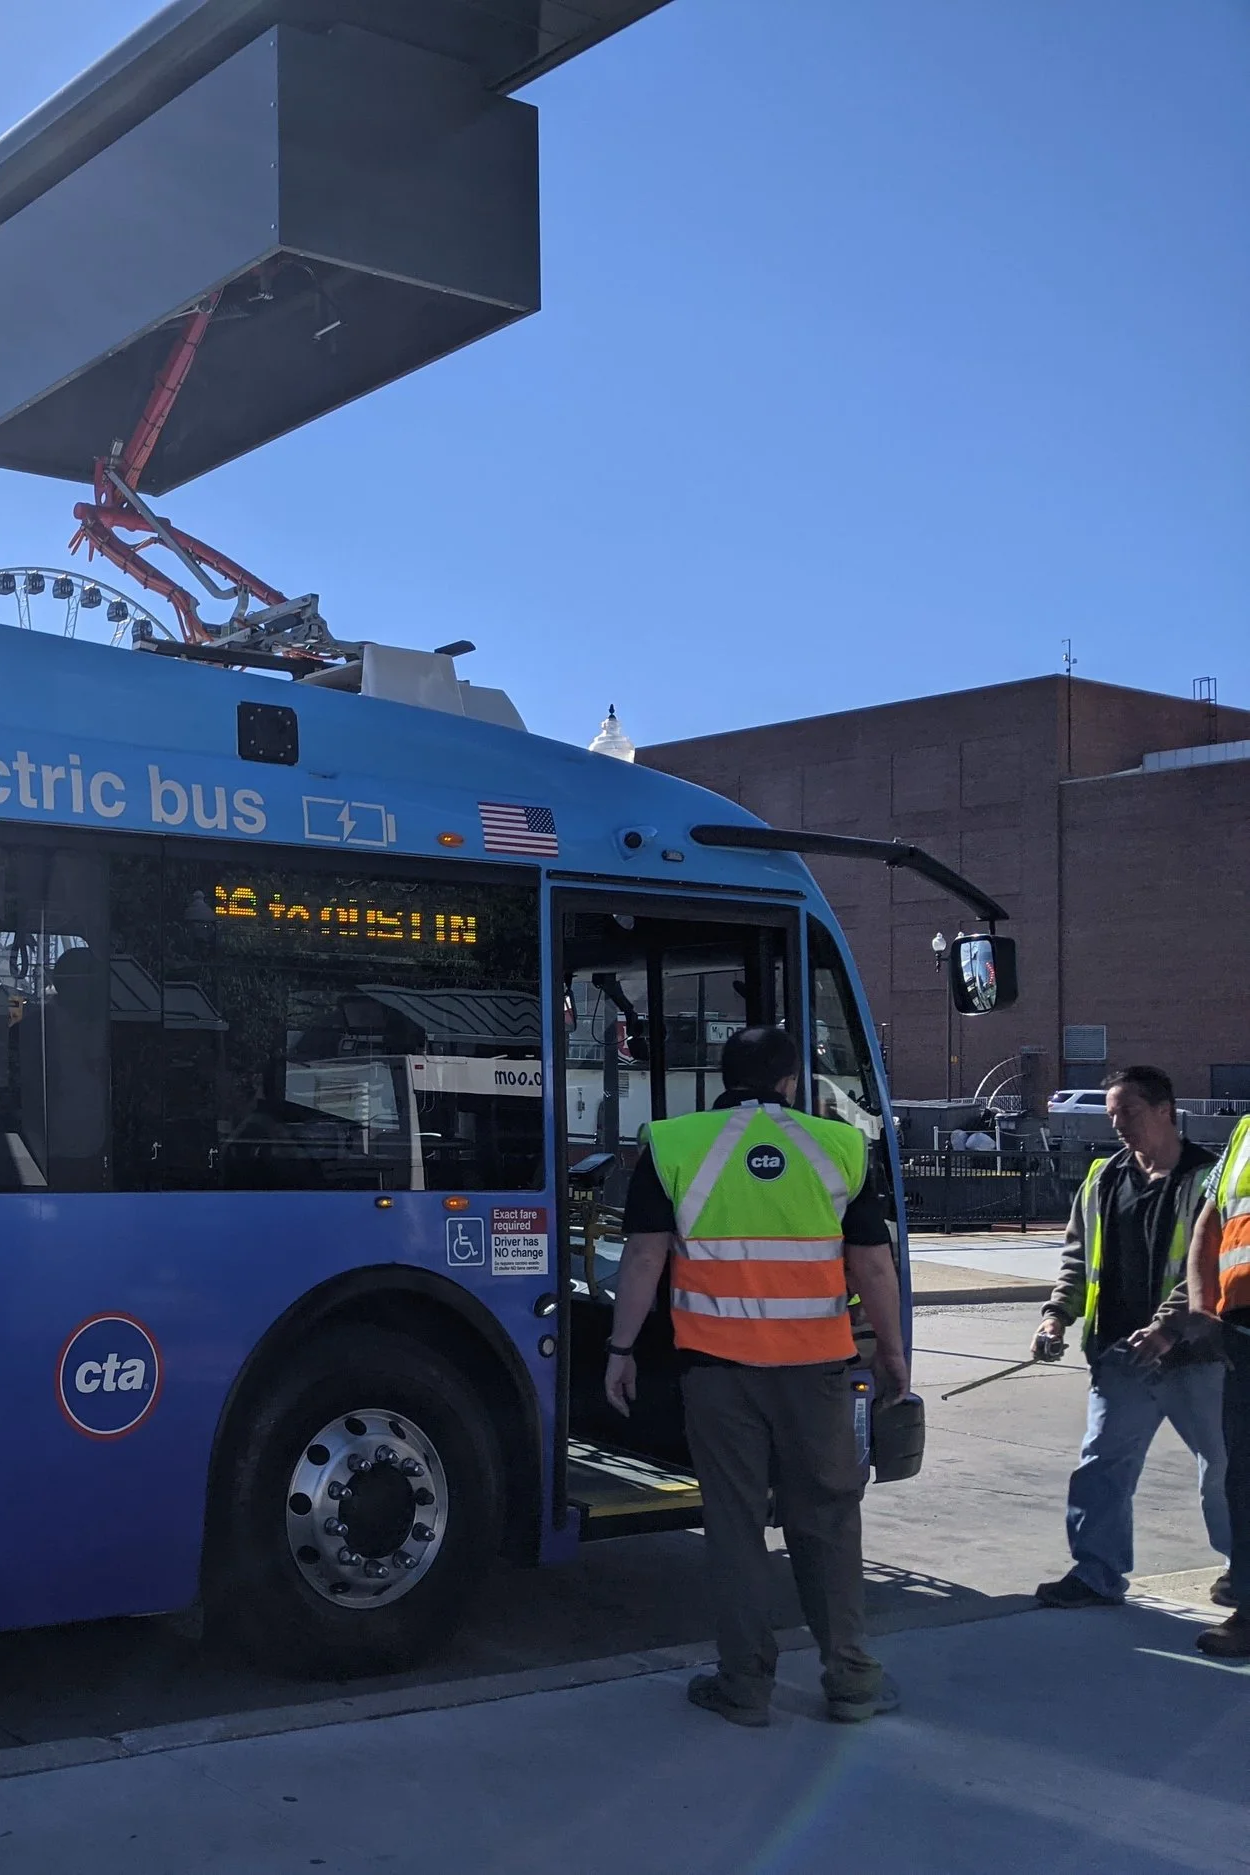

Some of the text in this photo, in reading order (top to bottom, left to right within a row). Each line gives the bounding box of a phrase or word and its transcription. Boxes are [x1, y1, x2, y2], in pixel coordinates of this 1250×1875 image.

[148, 764, 267, 834] bus
[751, 1155, 781, 1168] cta
[493, 1209, 538, 1219] Exact fare
[493, 1221, 531, 1232] required
[494, 1236, 539, 1247] Driver has
[494, 1247, 543, 1259] NO change
[75, 1353, 146, 1393] cta
